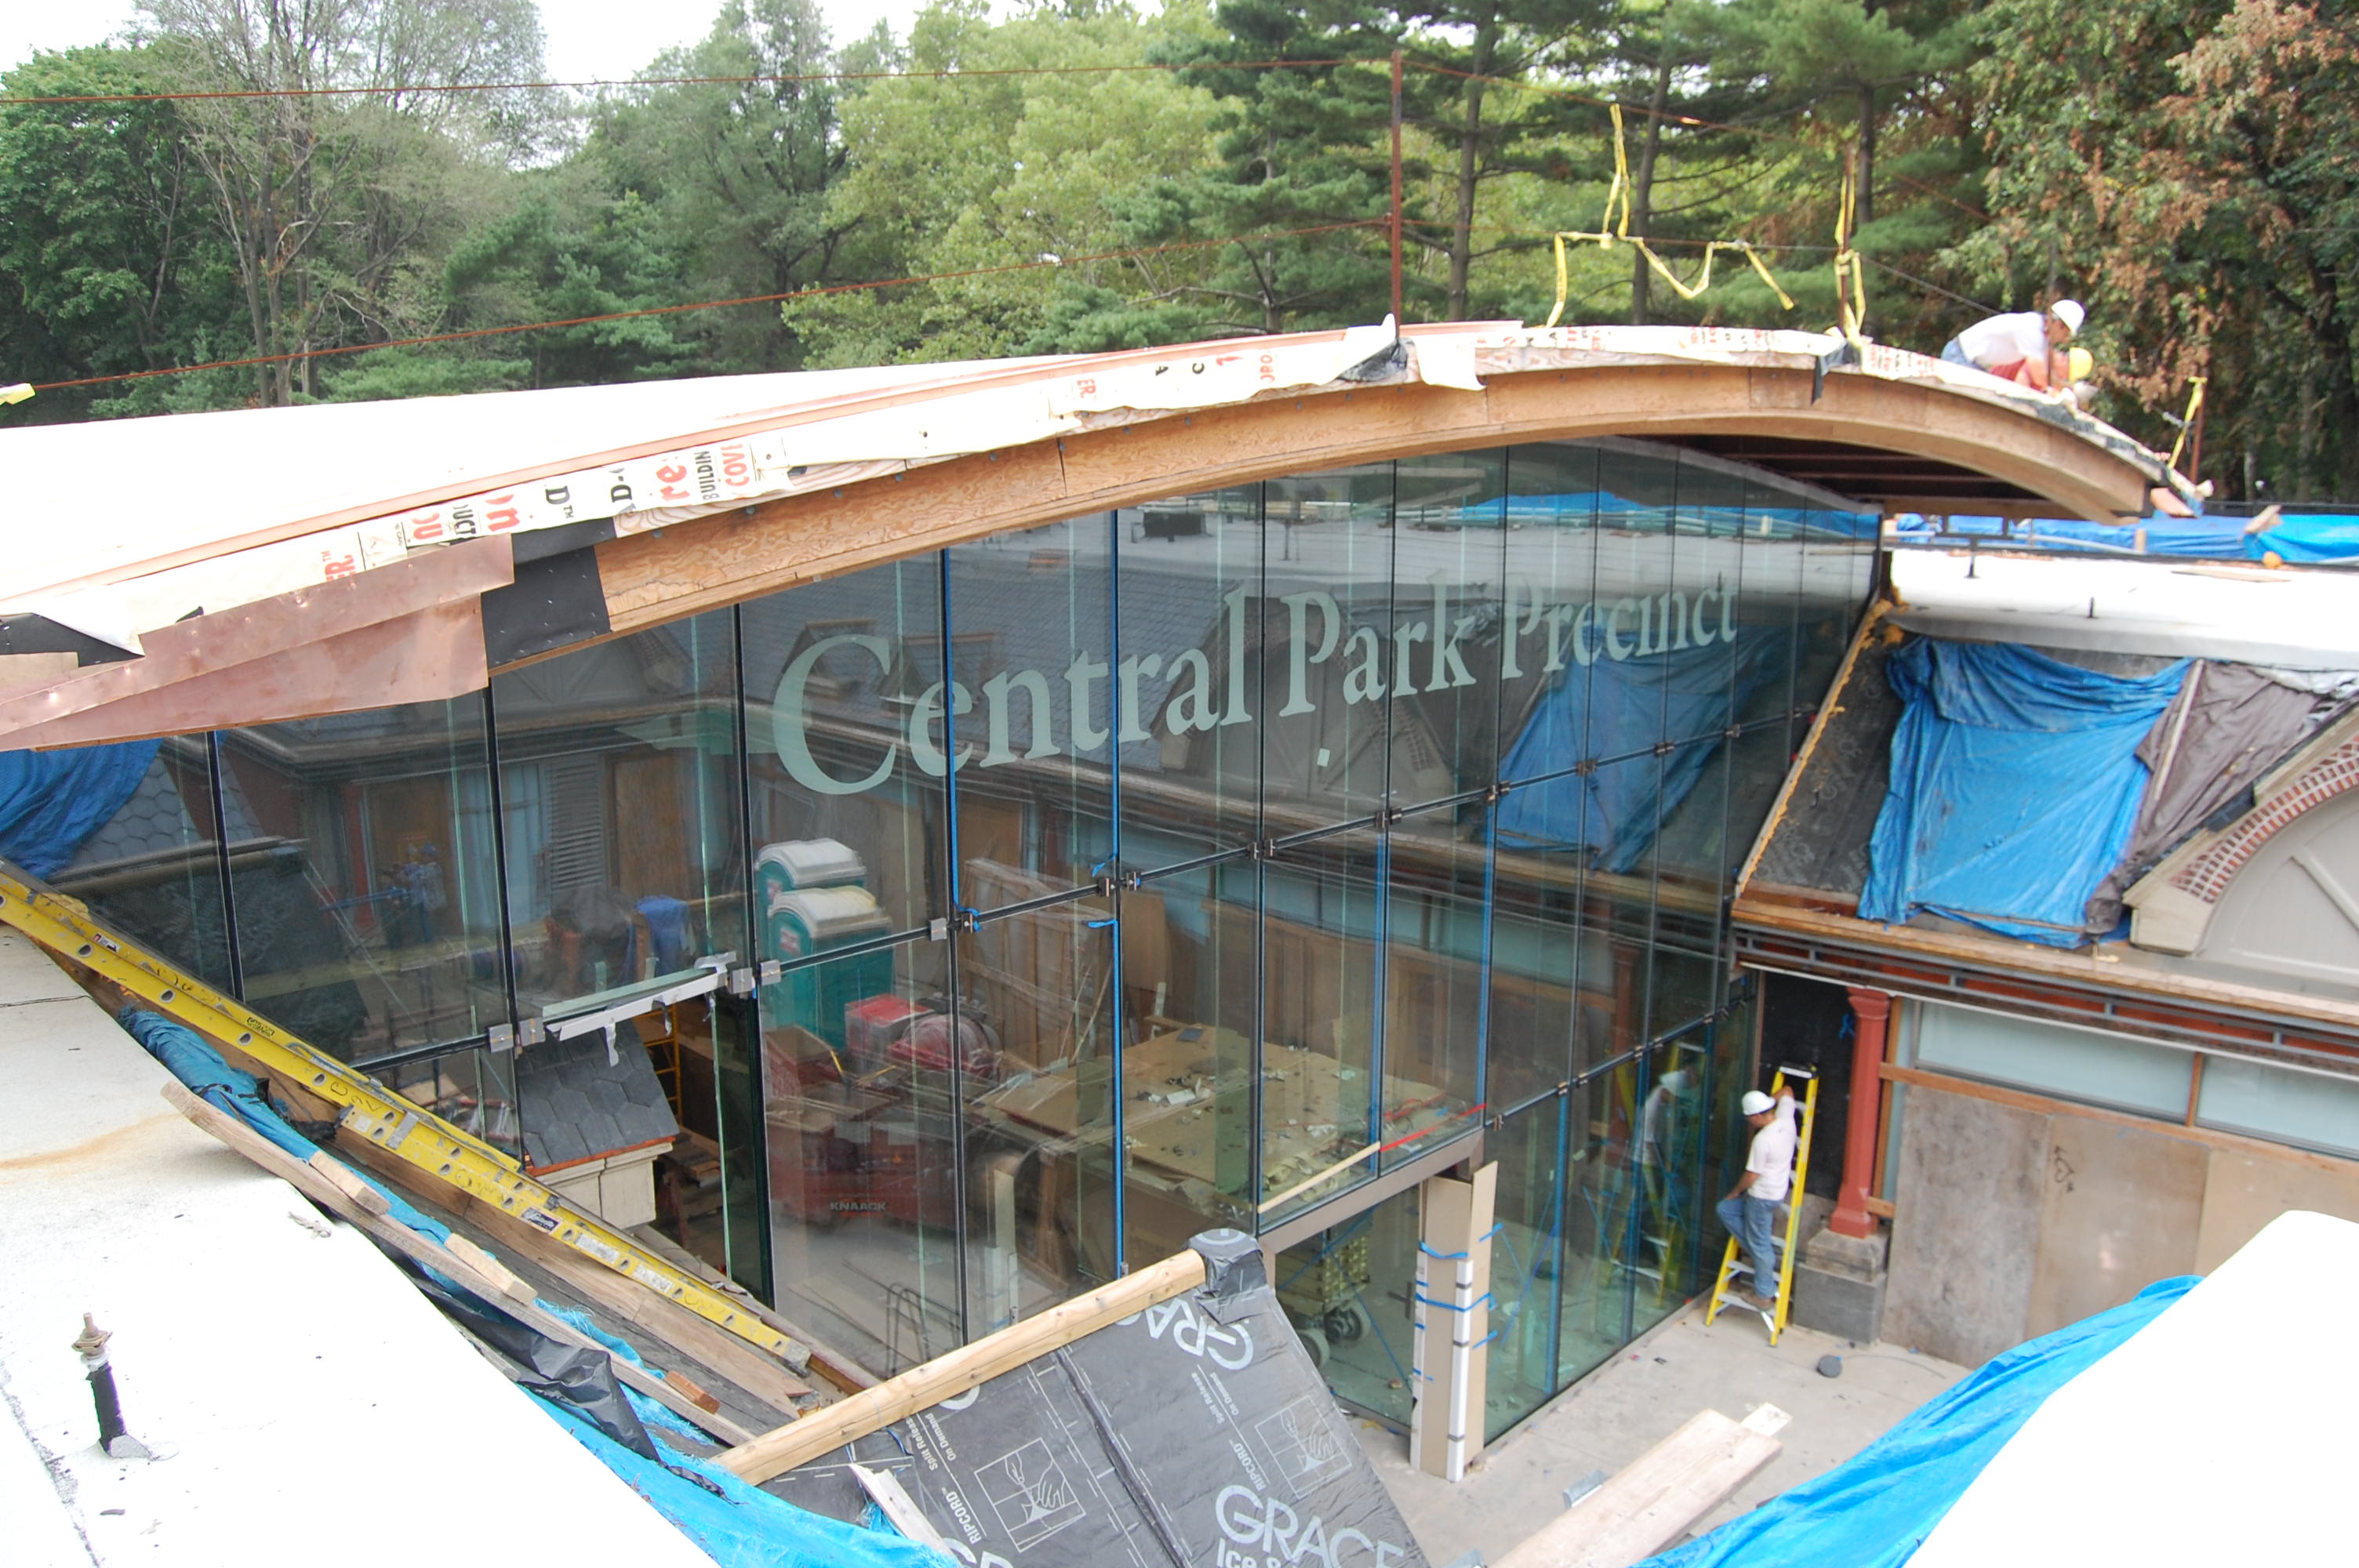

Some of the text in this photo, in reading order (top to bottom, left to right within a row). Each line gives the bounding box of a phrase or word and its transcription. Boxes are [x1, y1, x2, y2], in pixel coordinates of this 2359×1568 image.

[694, 451, 720, 501] BUILDIN
[772, 568, 1739, 795] Central Park Precinct
[830, 1201, 886, 1211] KNAACK
[906, 1417, 939, 1472] Split Releas
[925, 1413, 949, 1447] Demand
